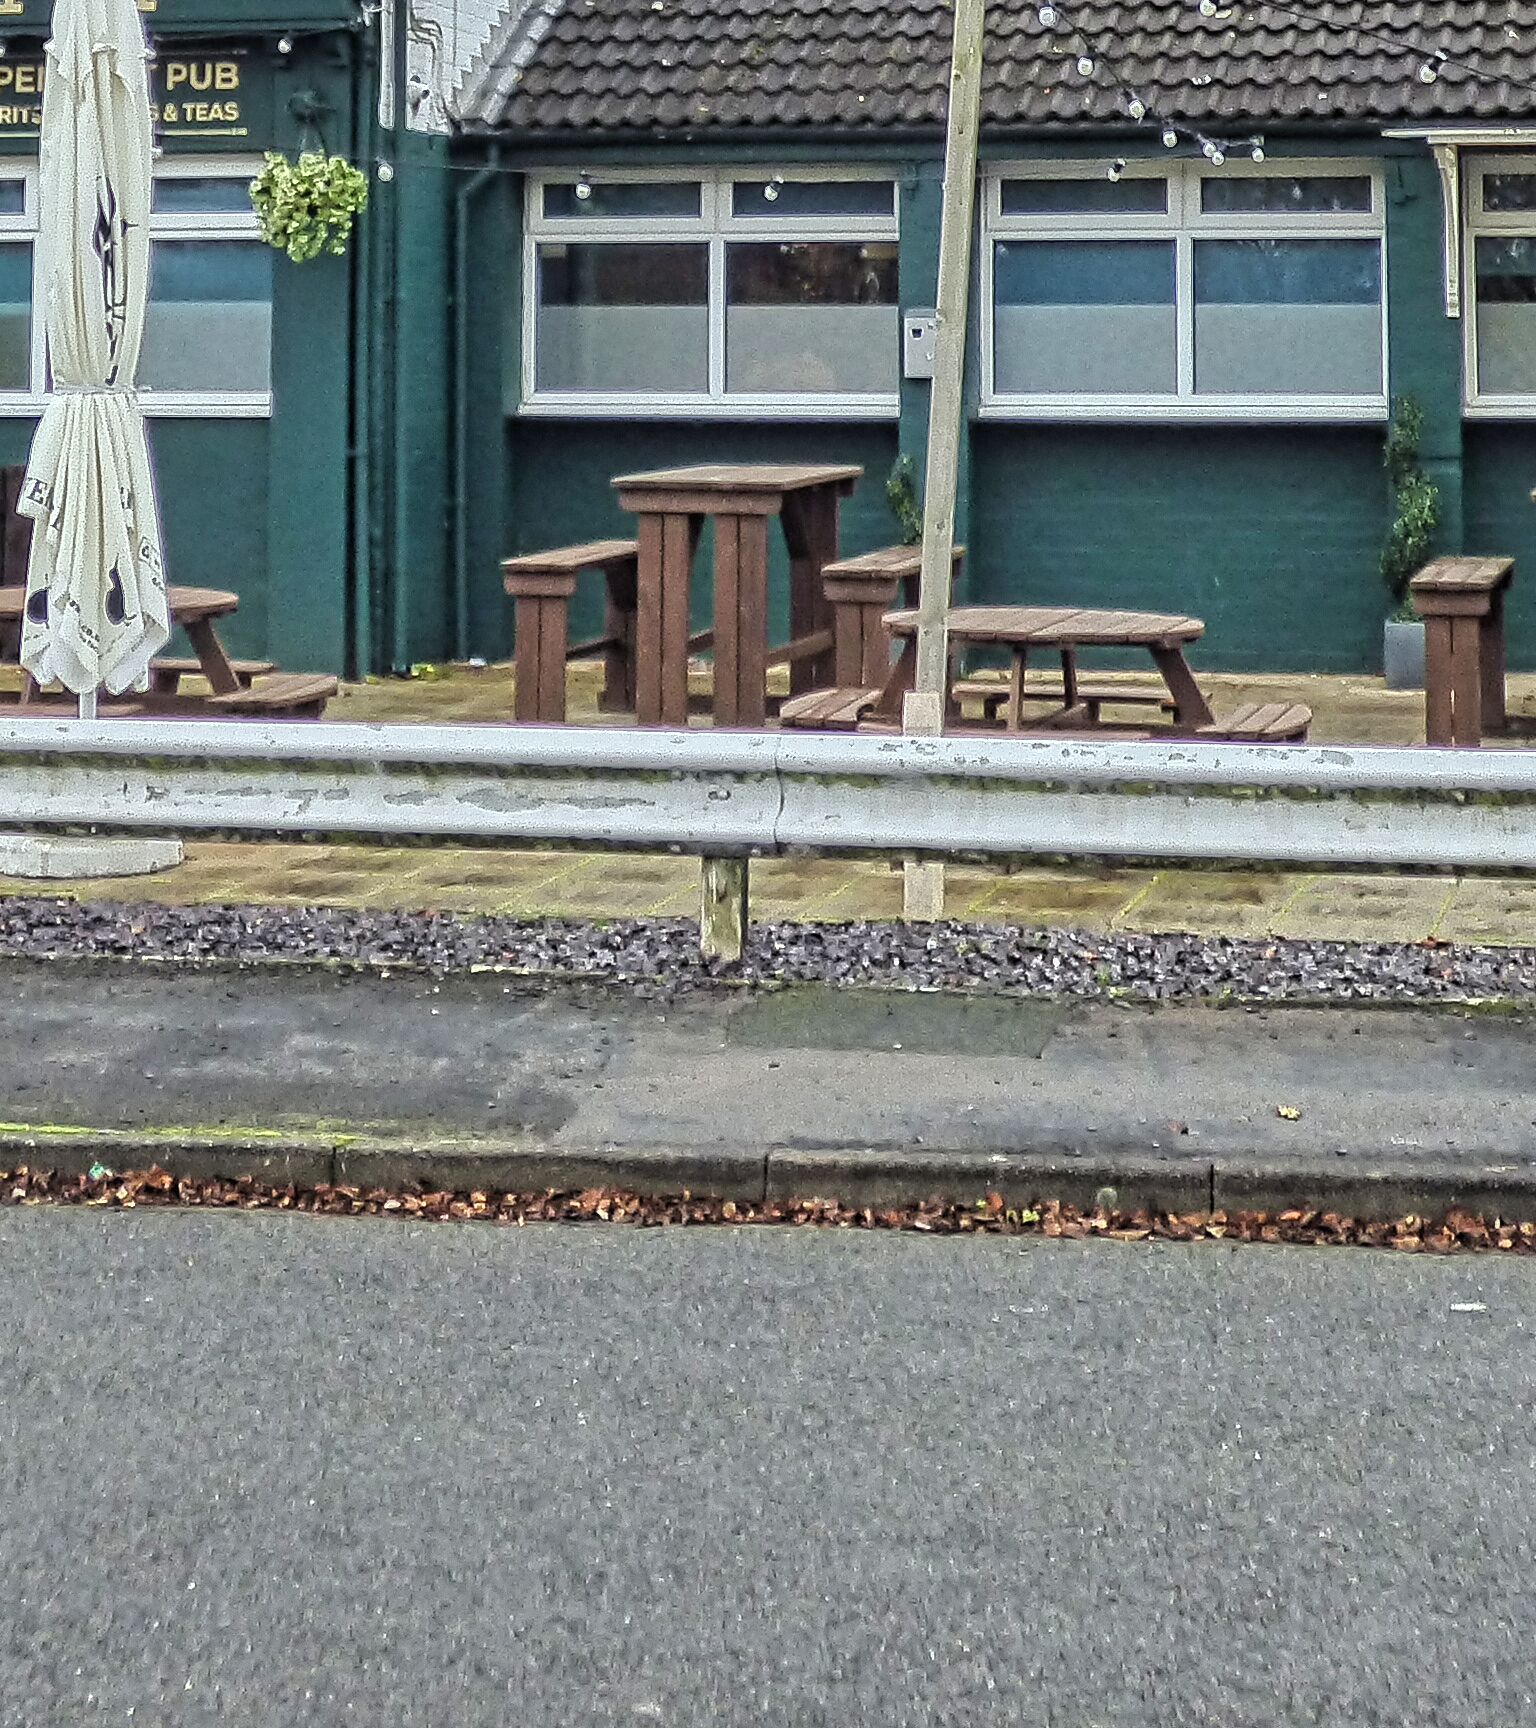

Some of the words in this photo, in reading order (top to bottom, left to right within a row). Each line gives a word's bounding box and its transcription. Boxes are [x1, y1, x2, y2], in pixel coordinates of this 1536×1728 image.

[166, 62, 239, 91] PUB
[163, 102, 178, 122] &
[183, 101, 239, 121] TEAS
